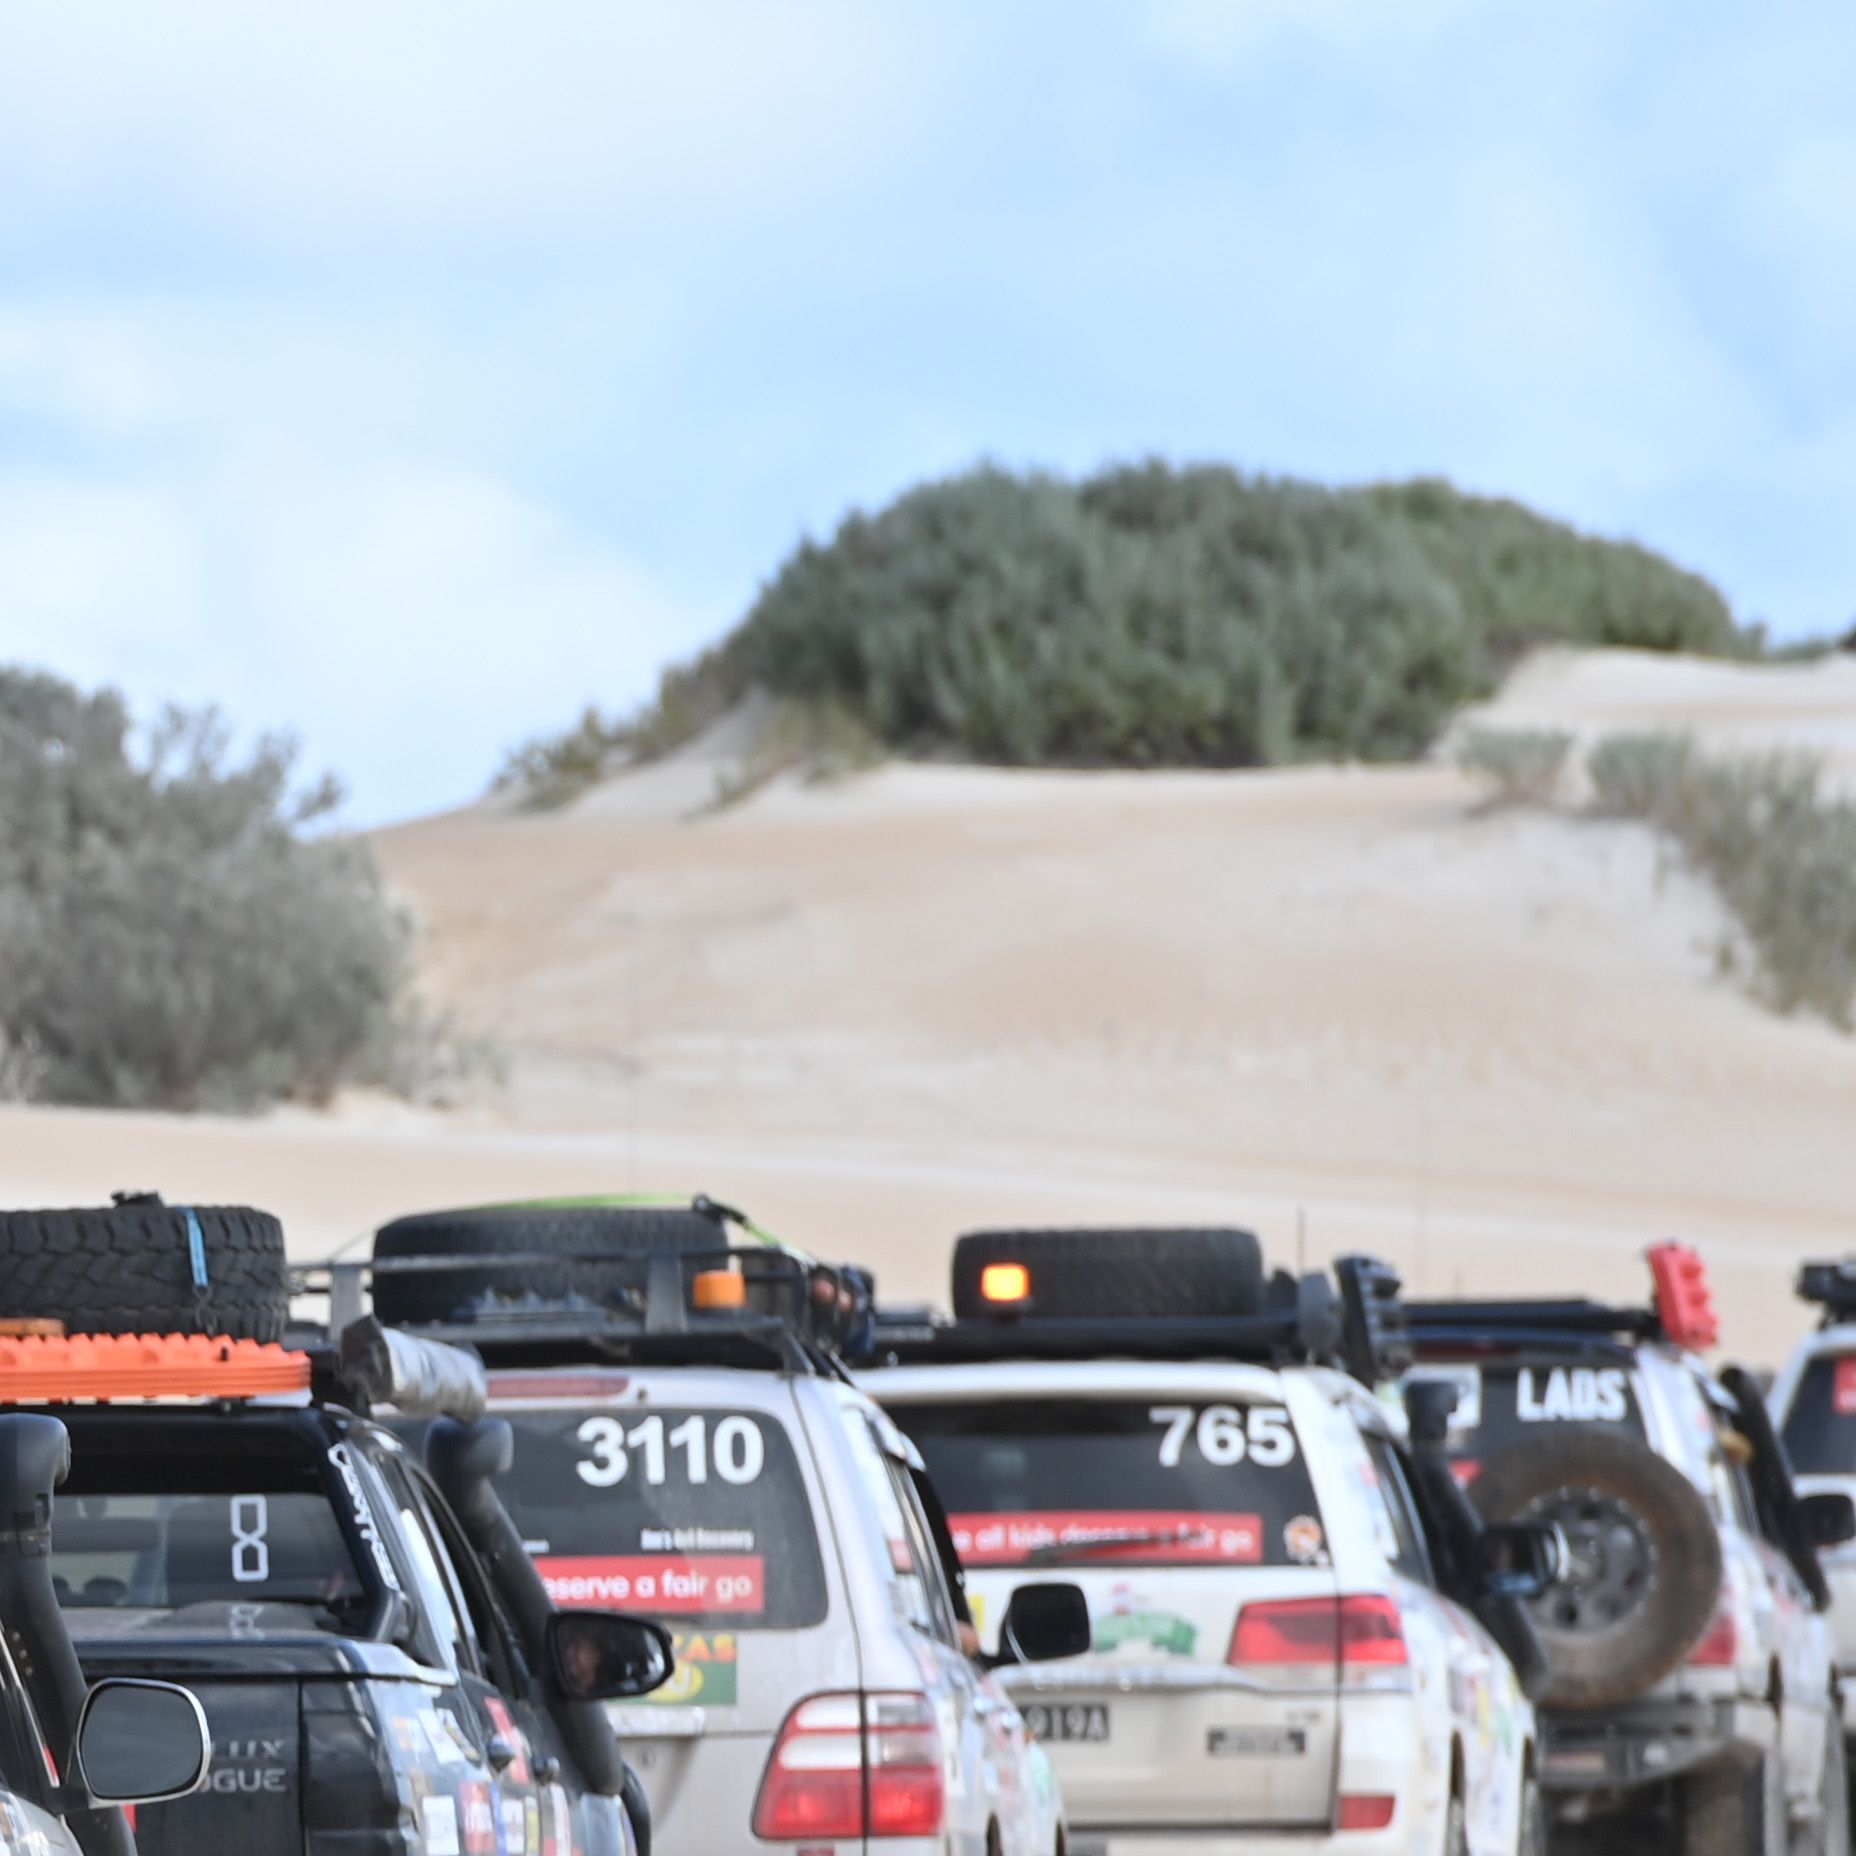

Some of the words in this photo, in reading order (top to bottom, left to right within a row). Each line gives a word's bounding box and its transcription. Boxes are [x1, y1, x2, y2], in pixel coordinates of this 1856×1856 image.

[577, 1416, 763, 1486] 3110
[1149, 1406, 1295, 1467] 765
[230, 1494, 269, 1582] 8
[541, 1574, 630, 1600] eserve
[637, 1576, 656, 1598] a
[661, 1569, 709, 1598] fair
[716, 1575, 753, 1603] go
